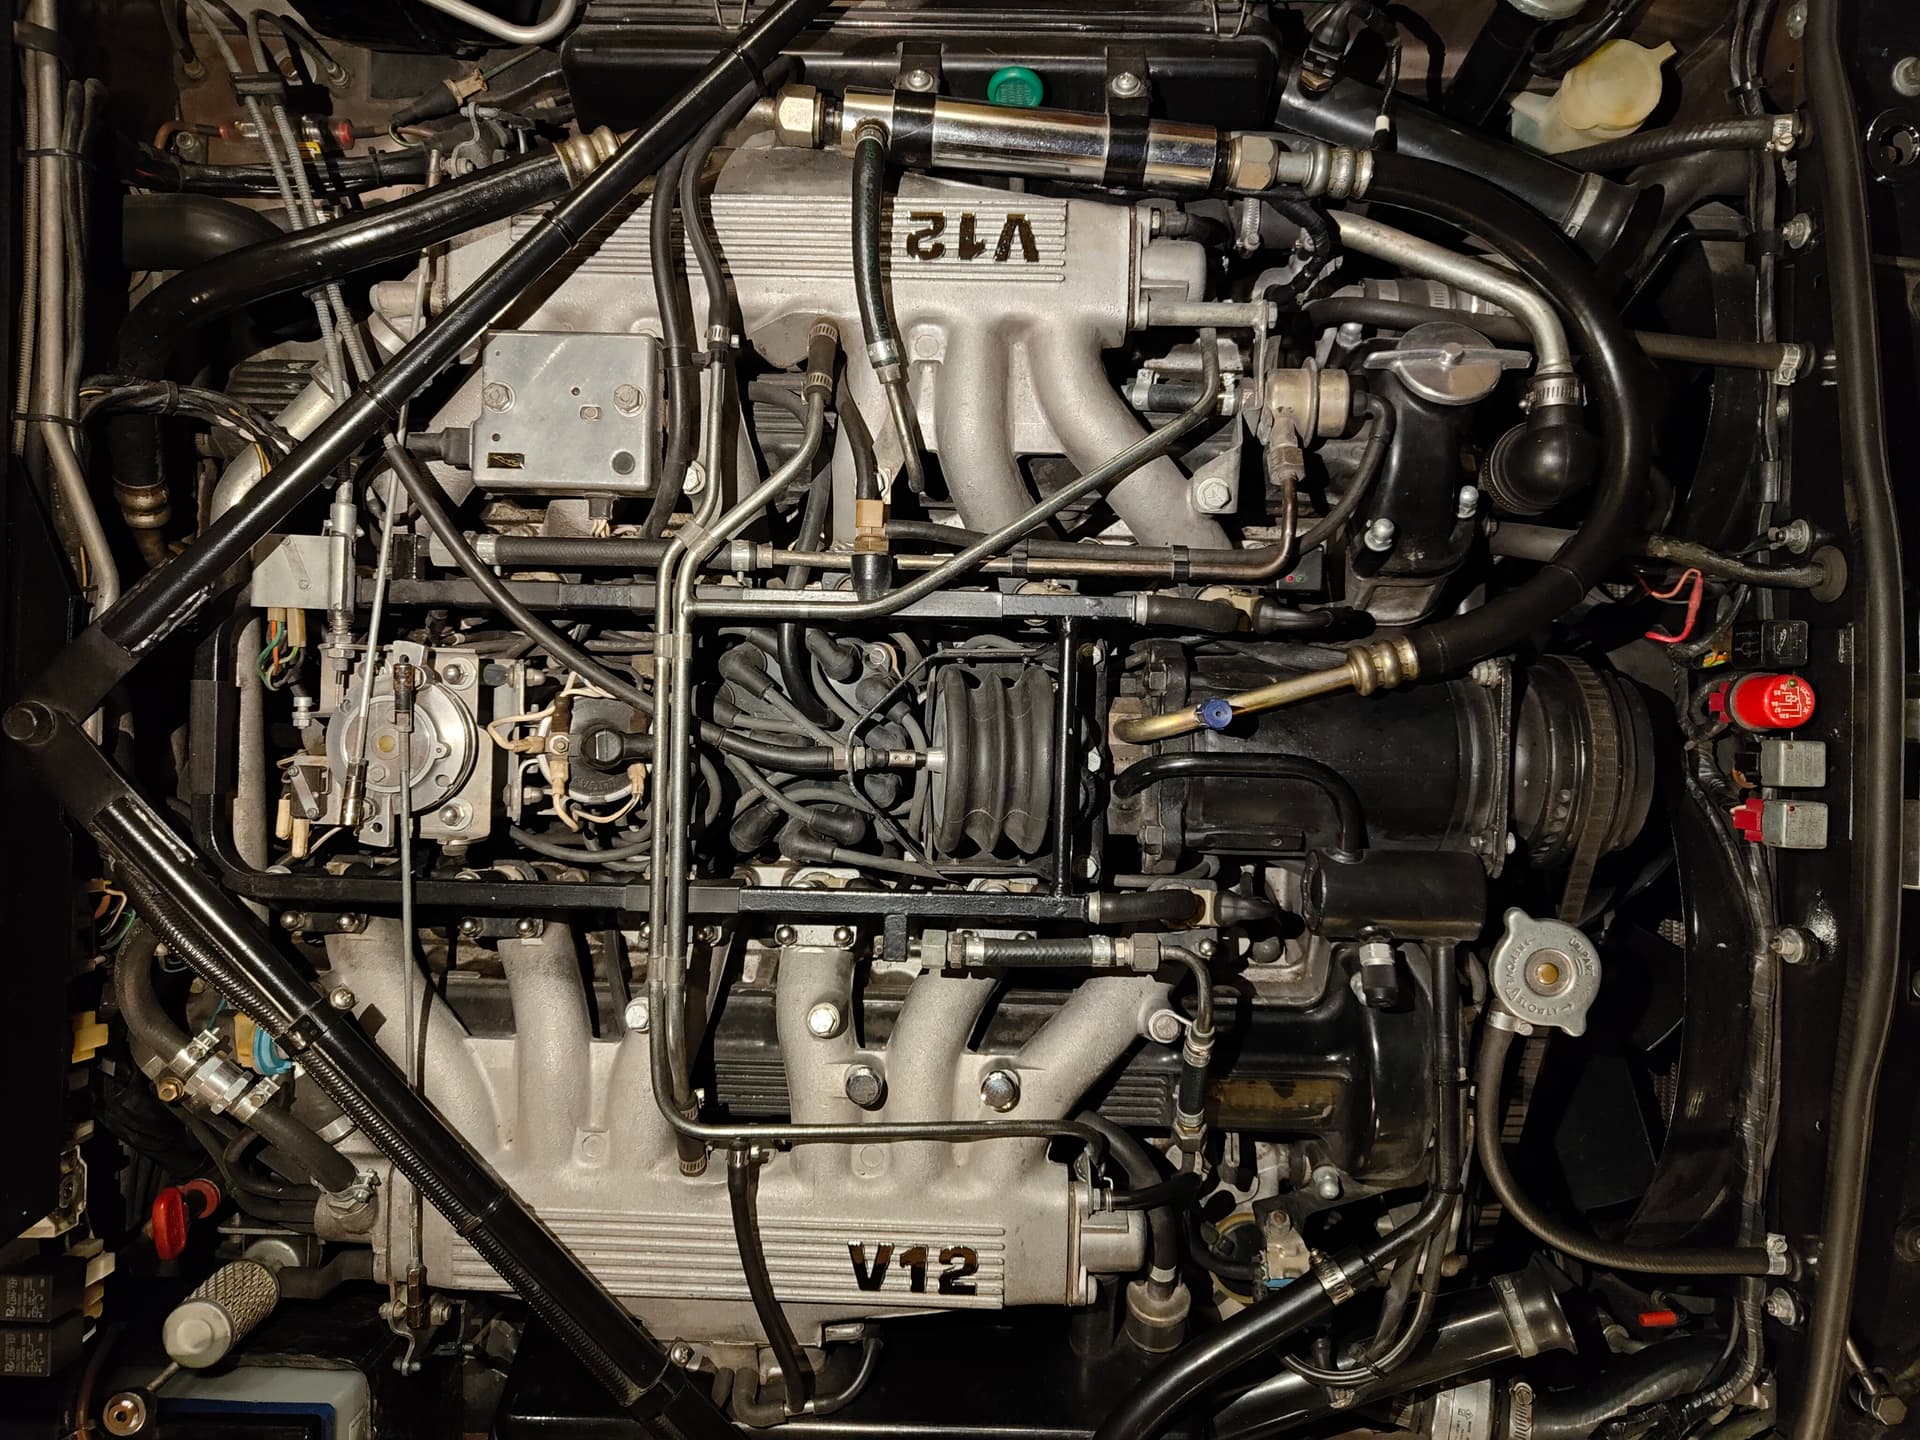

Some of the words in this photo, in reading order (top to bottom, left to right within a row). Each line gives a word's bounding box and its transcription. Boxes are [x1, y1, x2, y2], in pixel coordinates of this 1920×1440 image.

[906, 211, 1040, 263] V12
[1568, 935, 1595, 976] UNIPART
[1517, 996, 1559, 1016] SLOWLY
[847, 1240, 979, 1296] V12
